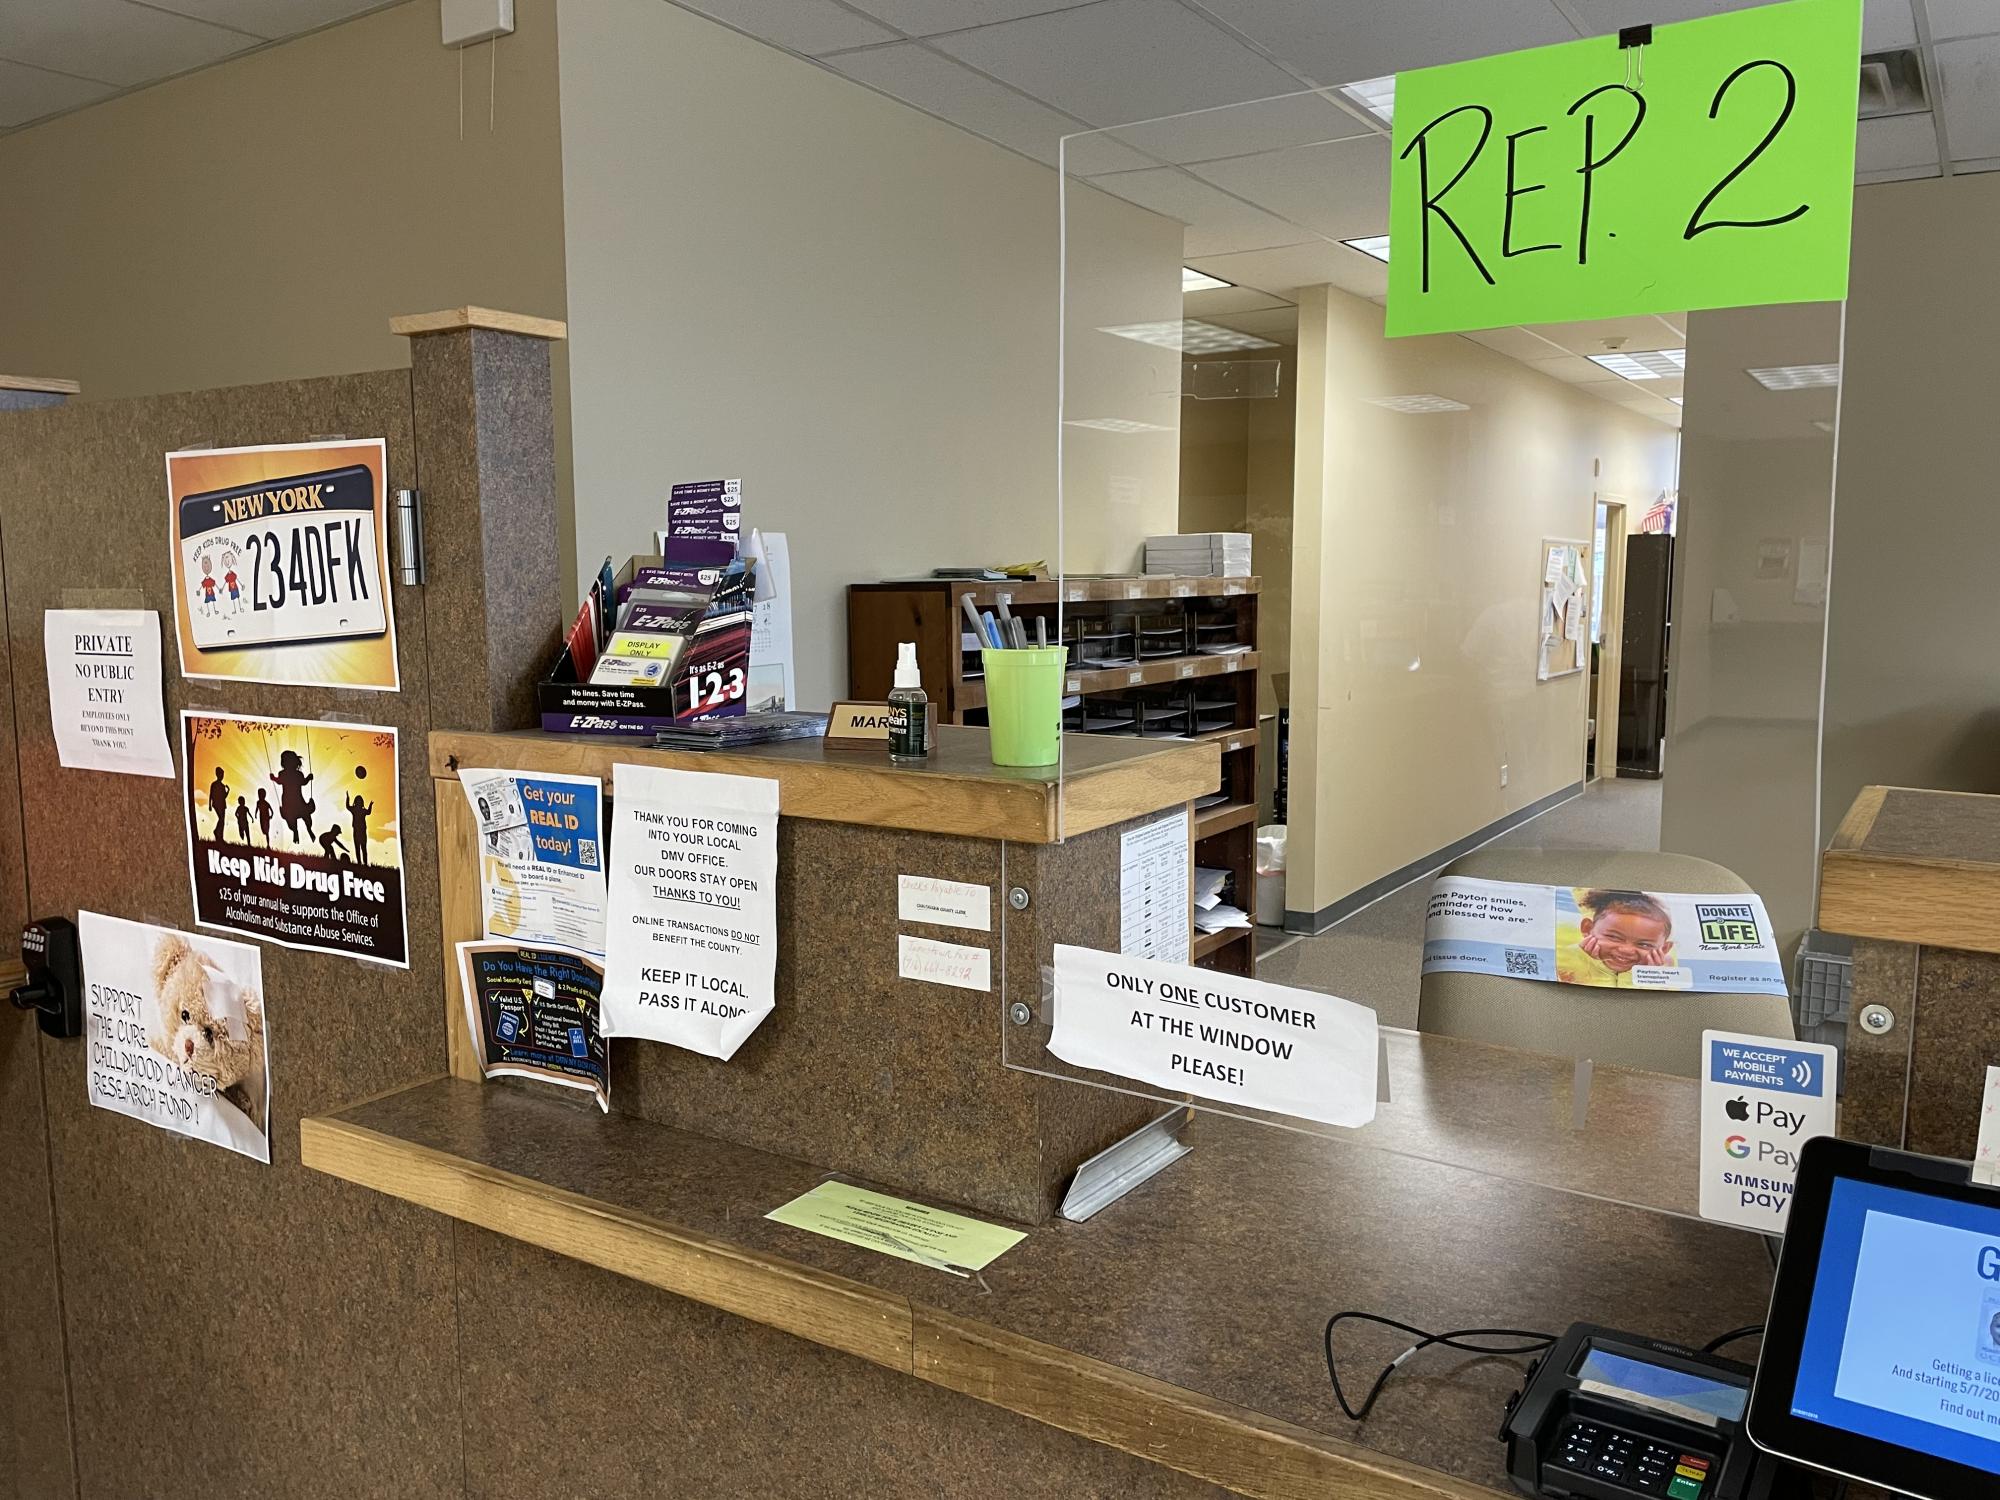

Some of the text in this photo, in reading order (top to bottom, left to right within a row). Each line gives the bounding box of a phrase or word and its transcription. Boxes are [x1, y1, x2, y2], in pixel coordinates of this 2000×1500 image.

[1400, 59, 1809, 293] REP. 2
[222, 484, 325, 523] NEW YORK
[193, 536, 242, 563] KEEP KIDS DRUG FREE
[245, 518, 369, 611] 234DFK
[632, 614, 691, 629] E-ZPass
[75, 635, 133, 653] PRIVATE
[627, 641, 660, 649] DISPLAY
[75, 664, 135, 680] NO PUBLIC
[88, 688, 124, 703] ENTRY
[572, 689, 581, 697] No
[602, 690, 618, 698] Save
[576, 700, 599, 708] money
[616, 700, 646, 708] E-ZPass.
[82, 710, 130, 722] EMPLOYEES ONLY
[569, 715, 618, 730] E-ZPass
[851, 715, 889, 729] MAR
[81, 724, 103, 733] BEYOND
[118, 728, 134, 736] POINT
[92, 739, 111, 748] THANK
[523, 785, 544, 802] Get
[547, 789, 575, 806] your
[530, 810, 579, 830] REAL ID
[634, 811, 757, 837] THANK YOU FOR COMING
[535, 835, 572, 856] today!
[648, 829, 741, 851] INTO YOUR LOCAL
[532, 865, 545, 873] REAL
[661, 850, 728, 868] DMV OFFICE.
[208, 848, 385, 903] Keep Kids Drug Free
[634, 864, 758, 892] OUR DOORS STAY OPEN
[653, 886, 740, 908] THANKS TO YOU!
[1431, 901, 1473, 909] reminder
[1491, 905, 1513, 913] how
[1451, 892, 1487, 902] Payton
[219, 887, 379, 928] $25 of your annual fee supports the Office of
[1444, 910, 1485, 919] blessed
[1702, 907, 1749, 917] DONATE
[225, 906, 375, 947] Alcoholism and Substance Abuse Services.
[632, 916, 760, 944] ONLINE TRANSACTIONS DO NOT
[1706, 925, 1755, 940] LIFE
[653, 933, 743, 955] BENEFIT THE COUNTY.
[1460, 954, 1487, 962] donor.
[483, 961, 495, 971] Do
[499, 961, 513, 971] You
[515, 962, 533, 974] Have
[535, 965, 548, 976] the
[549, 967, 570, 980] Right
[503, 976, 522, 985] Security
[641, 967, 749, 999] KEEP IT LOCAL.
[91, 984, 142, 1020] SUPPORT
[499, 996, 513, 1004] Valid
[500, 1003, 525, 1012] Passport
[639, 992, 680, 1009] PASS
[685, 997, 697, 1011] IT
[1106, 971, 1317, 1030] ONLY ONE CUSTOMER
[92, 1013, 149, 1049] THE CURE
[1131, 1010, 1293, 1060] AT THE WINDOW
[1723, 1048, 1787, 1064] WE ACCEPT
[94, 1041, 219, 1100] CHILDHOOD CANCER
[1171, 1053, 1245, 1087] PLEASE!
[1733, 1060, 1776, 1074] MOBILE
[1725, 1070, 1784, 1086] PAYMENTS
[94, 1071, 156, 1111] RESEARCH
[1756, 1101, 1806, 1136] Pay
[1724, 1135, 1799, 1173] G Pay
[1723, 1172, 1794, 1194] SAMSUN
[1741, 1190, 1786, 1213] pay
[1892, 1364, 1958, 1394] And starting
[1932, 1358, 1981, 1381] Getting a
[1940, 1398, 1984, 1420] Find out
[1676, 1479, 1696, 1487] Enter
